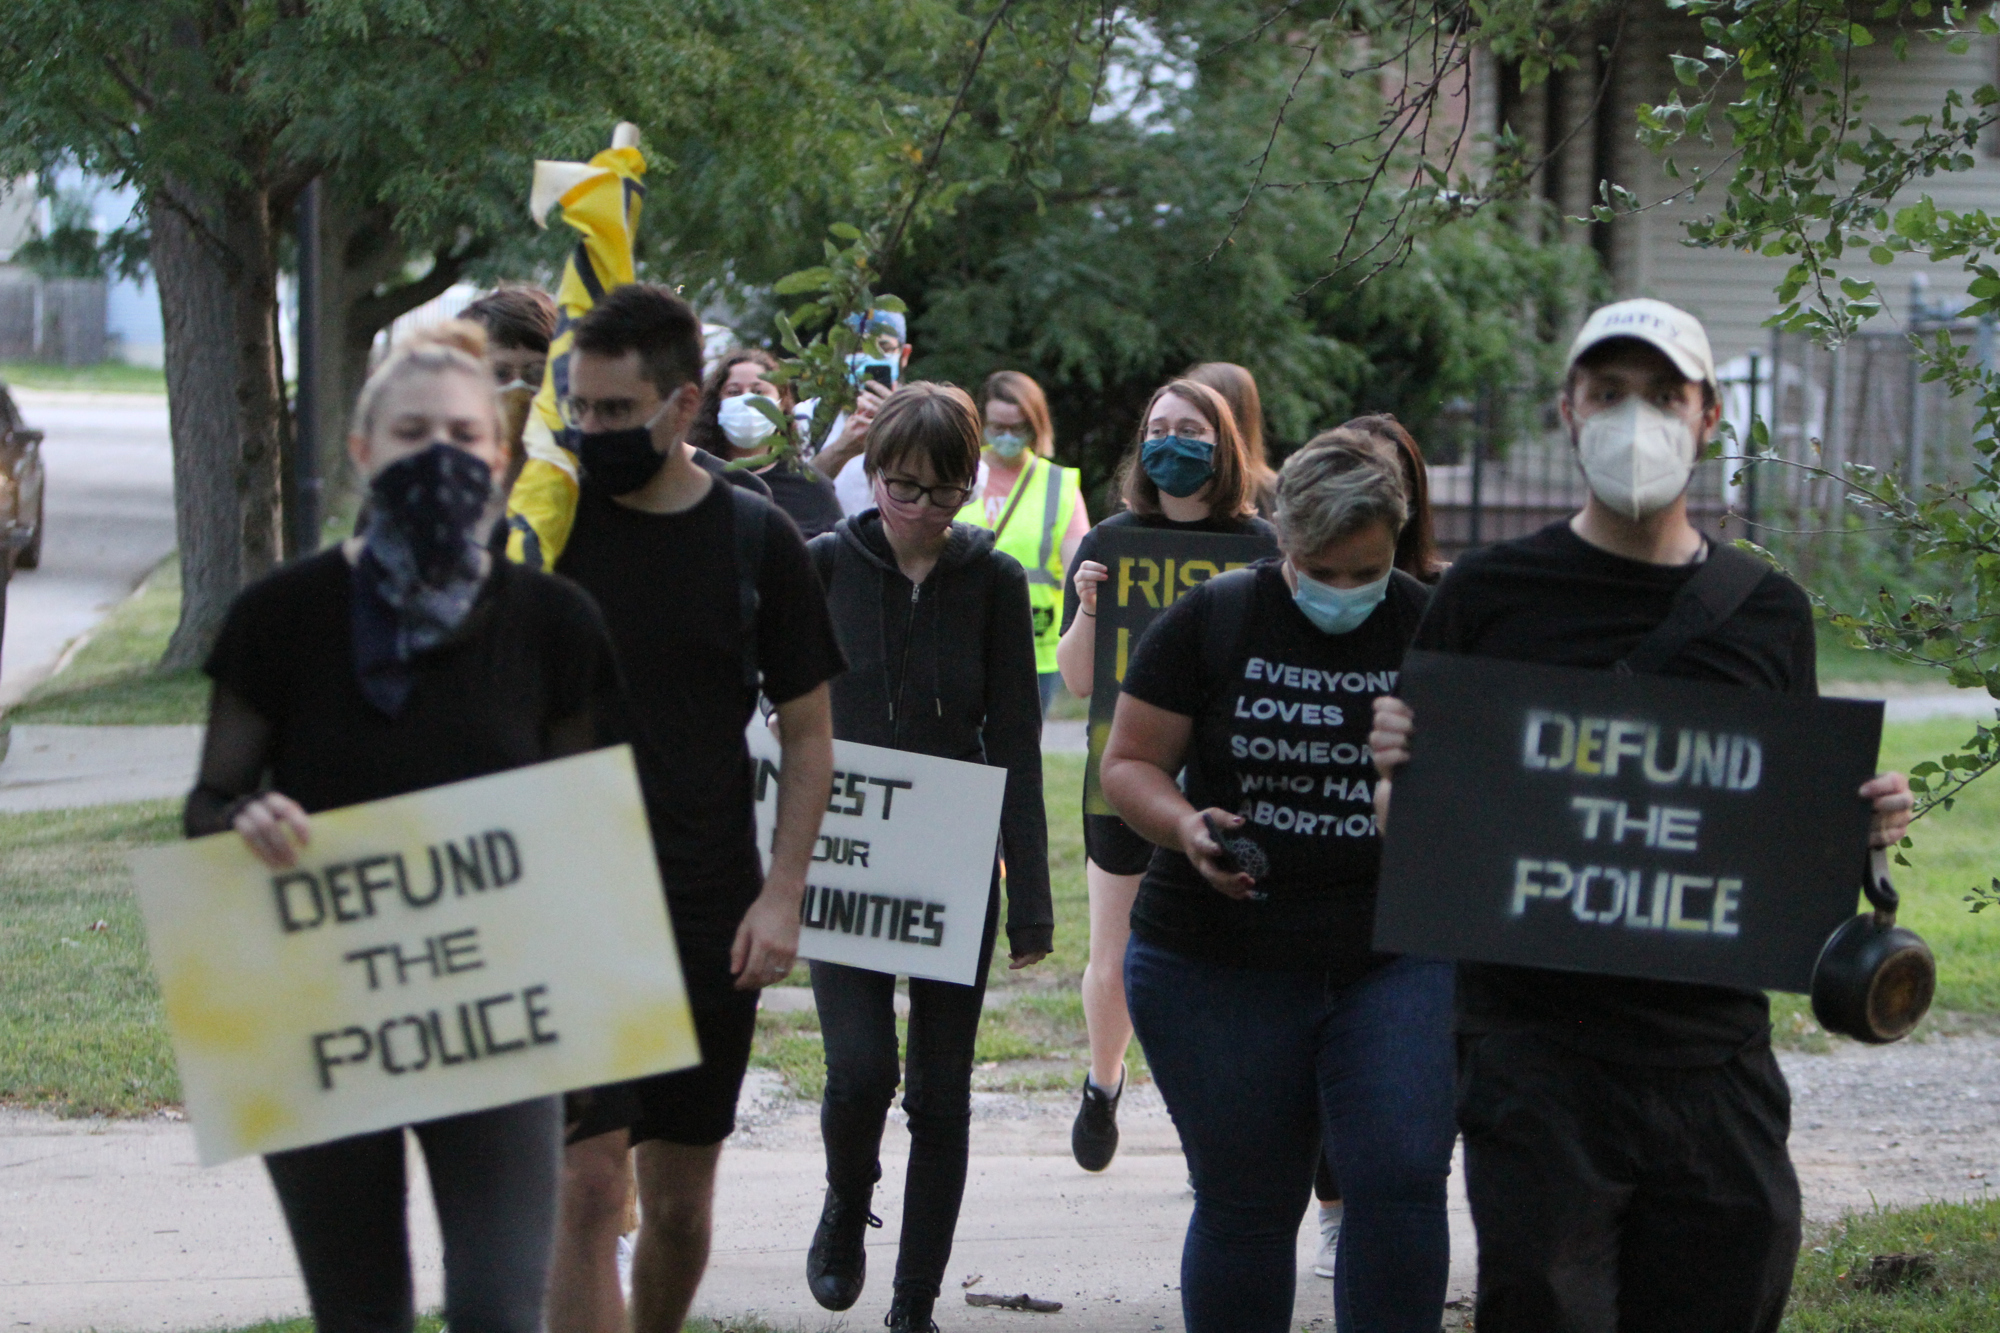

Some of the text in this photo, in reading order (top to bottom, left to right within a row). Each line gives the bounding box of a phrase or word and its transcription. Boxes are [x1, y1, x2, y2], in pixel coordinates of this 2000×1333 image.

[1234, 695, 1345, 727] LOVES
[1522, 709, 1763, 791] DEFUND
[1236, 771, 1371, 804] WHO HA
[1571, 796, 1702, 851] THE
[271, 828, 524, 935] DEFUND
[1511, 858, 1744, 936] POLICE
[343, 927, 486, 991] THE
[311, 983, 560, 1091] POLICE
